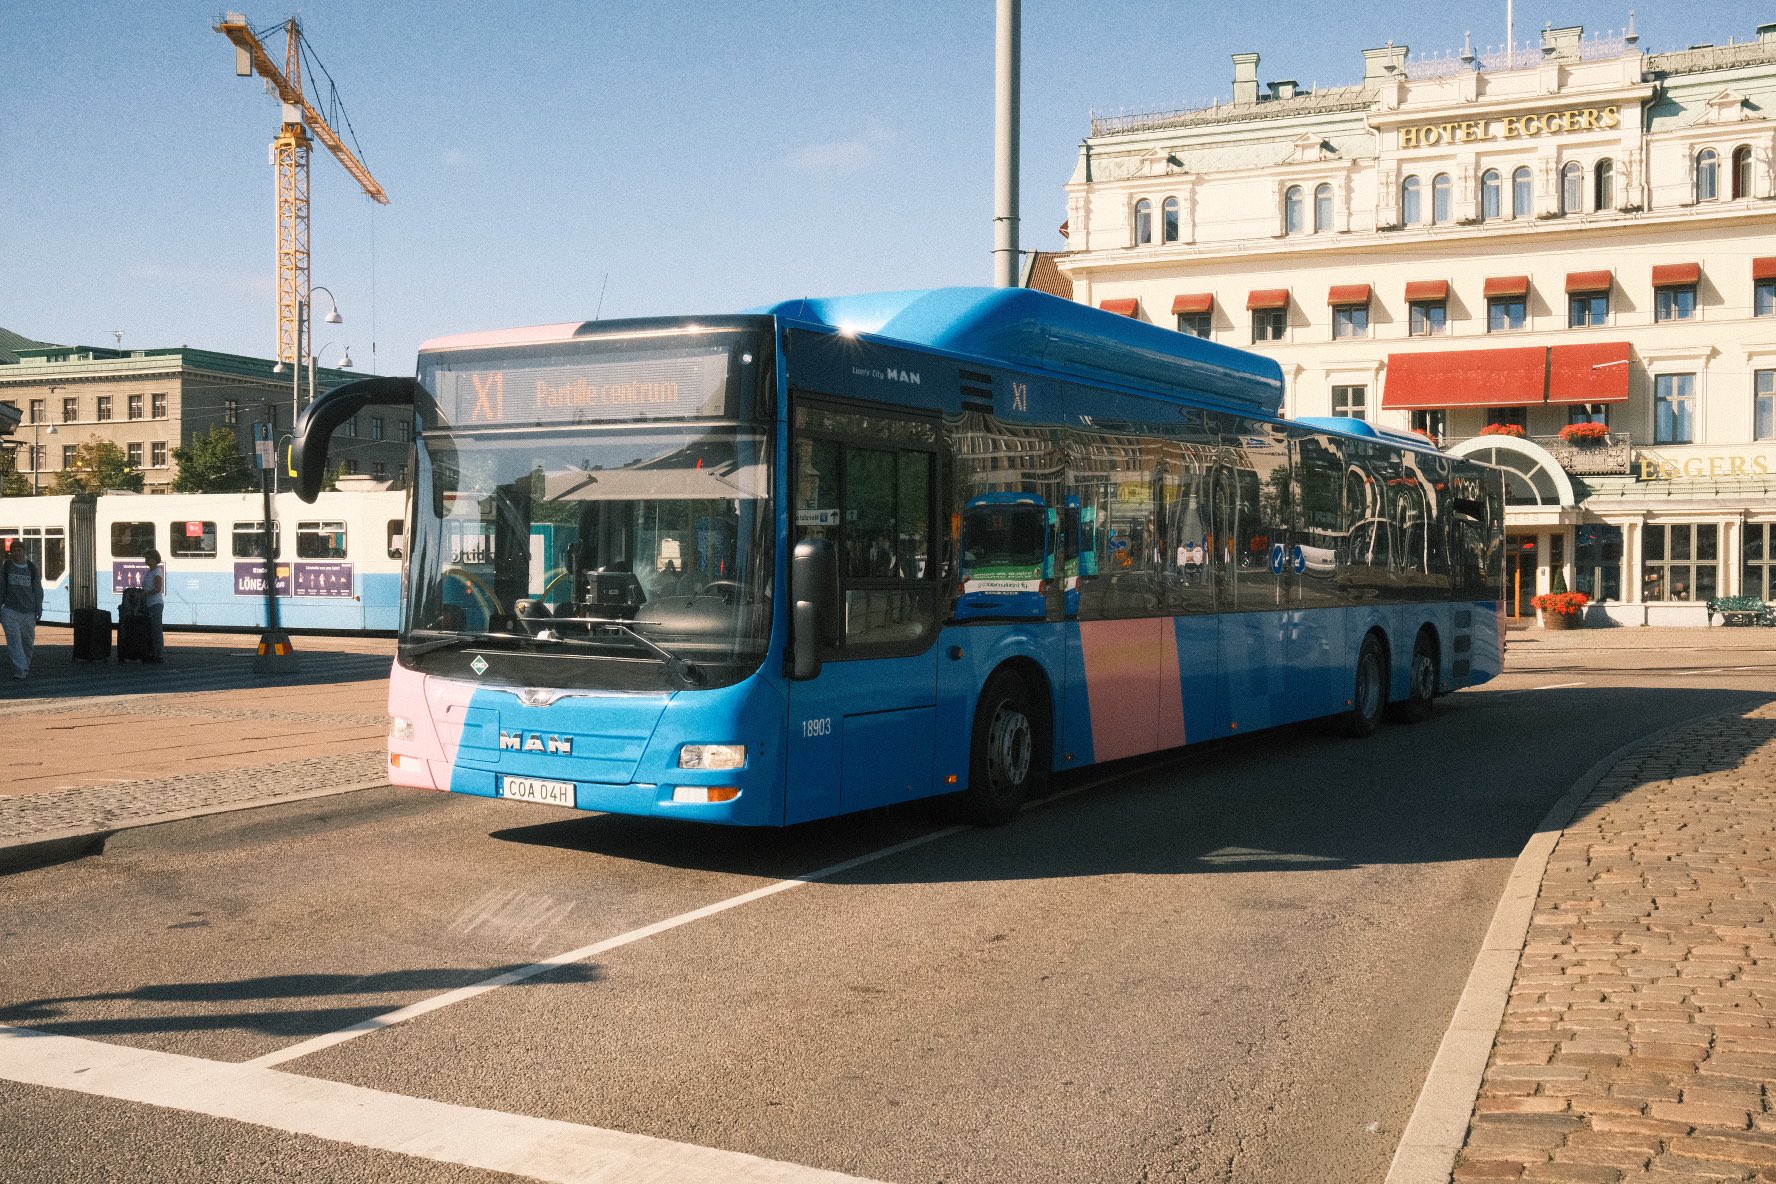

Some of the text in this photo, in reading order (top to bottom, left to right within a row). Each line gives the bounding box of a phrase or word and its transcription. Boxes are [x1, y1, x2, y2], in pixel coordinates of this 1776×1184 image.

[1401, 106, 1617, 147] HOTEL EGGERS
[887, 367, 921, 385] MAN
[471, 372, 504, 421] X1
[1013, 382, 1027, 411] X1
[1641, 455, 1768, 481] EGGERS
[1505, 513, 1540, 523] GERS
[802, 717, 831, 738] 18903
[500, 731, 573, 756] MAN
[509, 780, 568, 803] COA 04H
